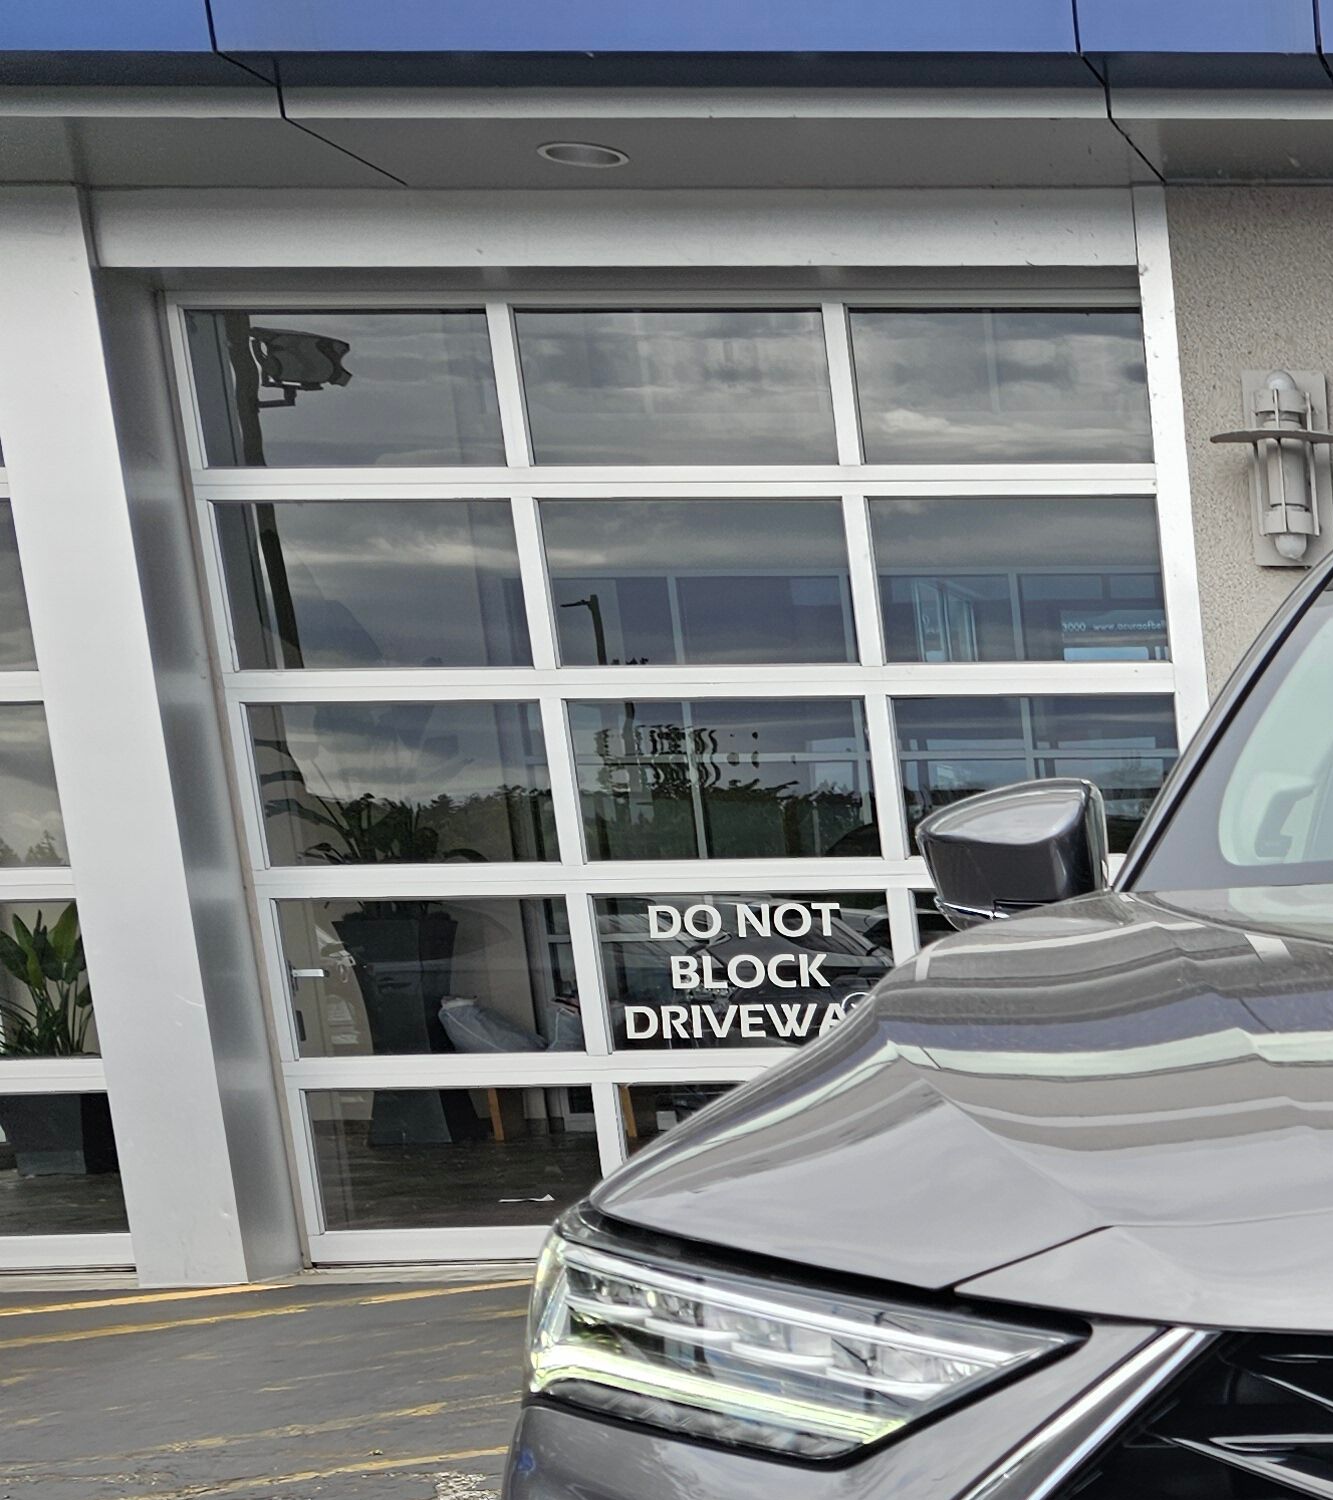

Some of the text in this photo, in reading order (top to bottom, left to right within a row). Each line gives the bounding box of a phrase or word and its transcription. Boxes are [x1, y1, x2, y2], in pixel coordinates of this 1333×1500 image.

[647, 902, 840, 939] DO NOT
[670, 953, 831, 990] BLOCK
[624, 1003, 857, 1040] DRIVEWA
